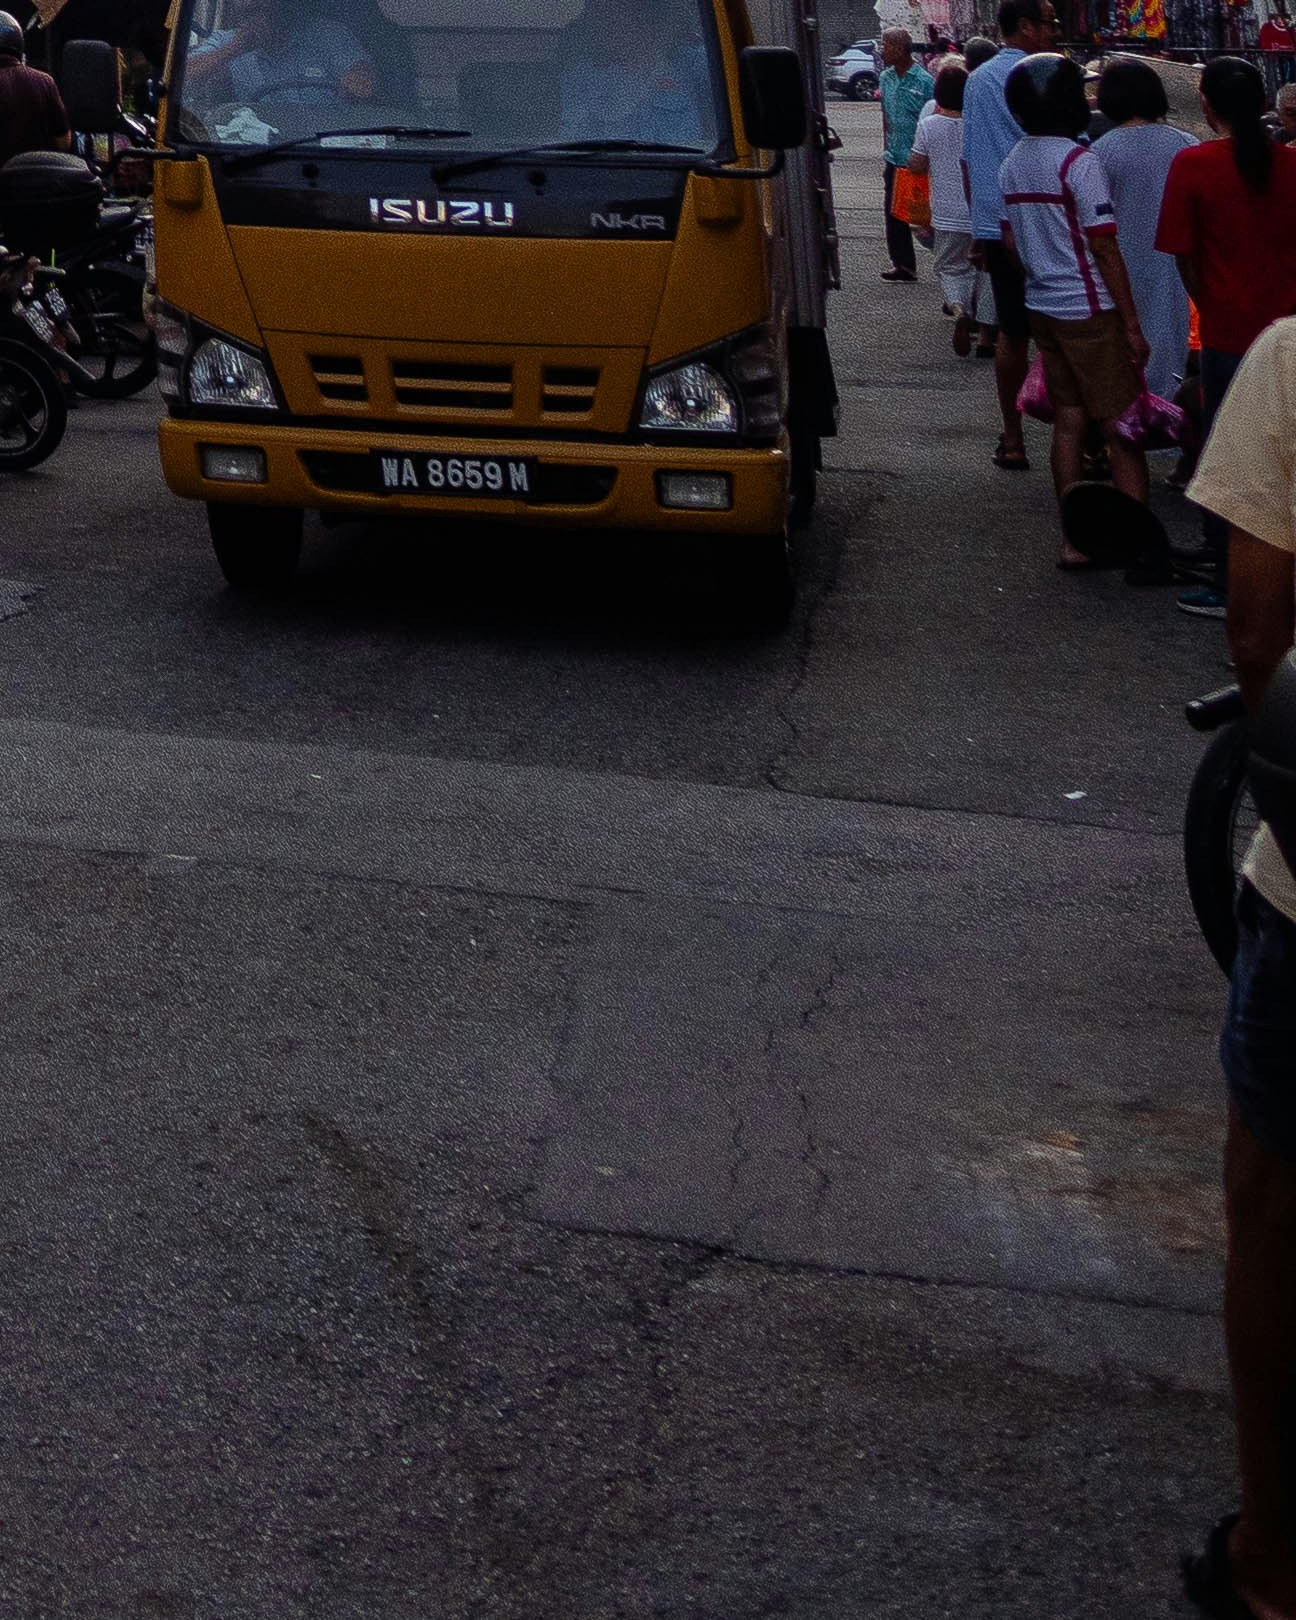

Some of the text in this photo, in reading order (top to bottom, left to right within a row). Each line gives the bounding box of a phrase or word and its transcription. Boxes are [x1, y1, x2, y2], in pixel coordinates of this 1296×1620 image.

[369, 197, 515, 228] ISUZU
[590, 210, 667, 231] NKR
[381, 456, 530, 492] WA 8659 M
